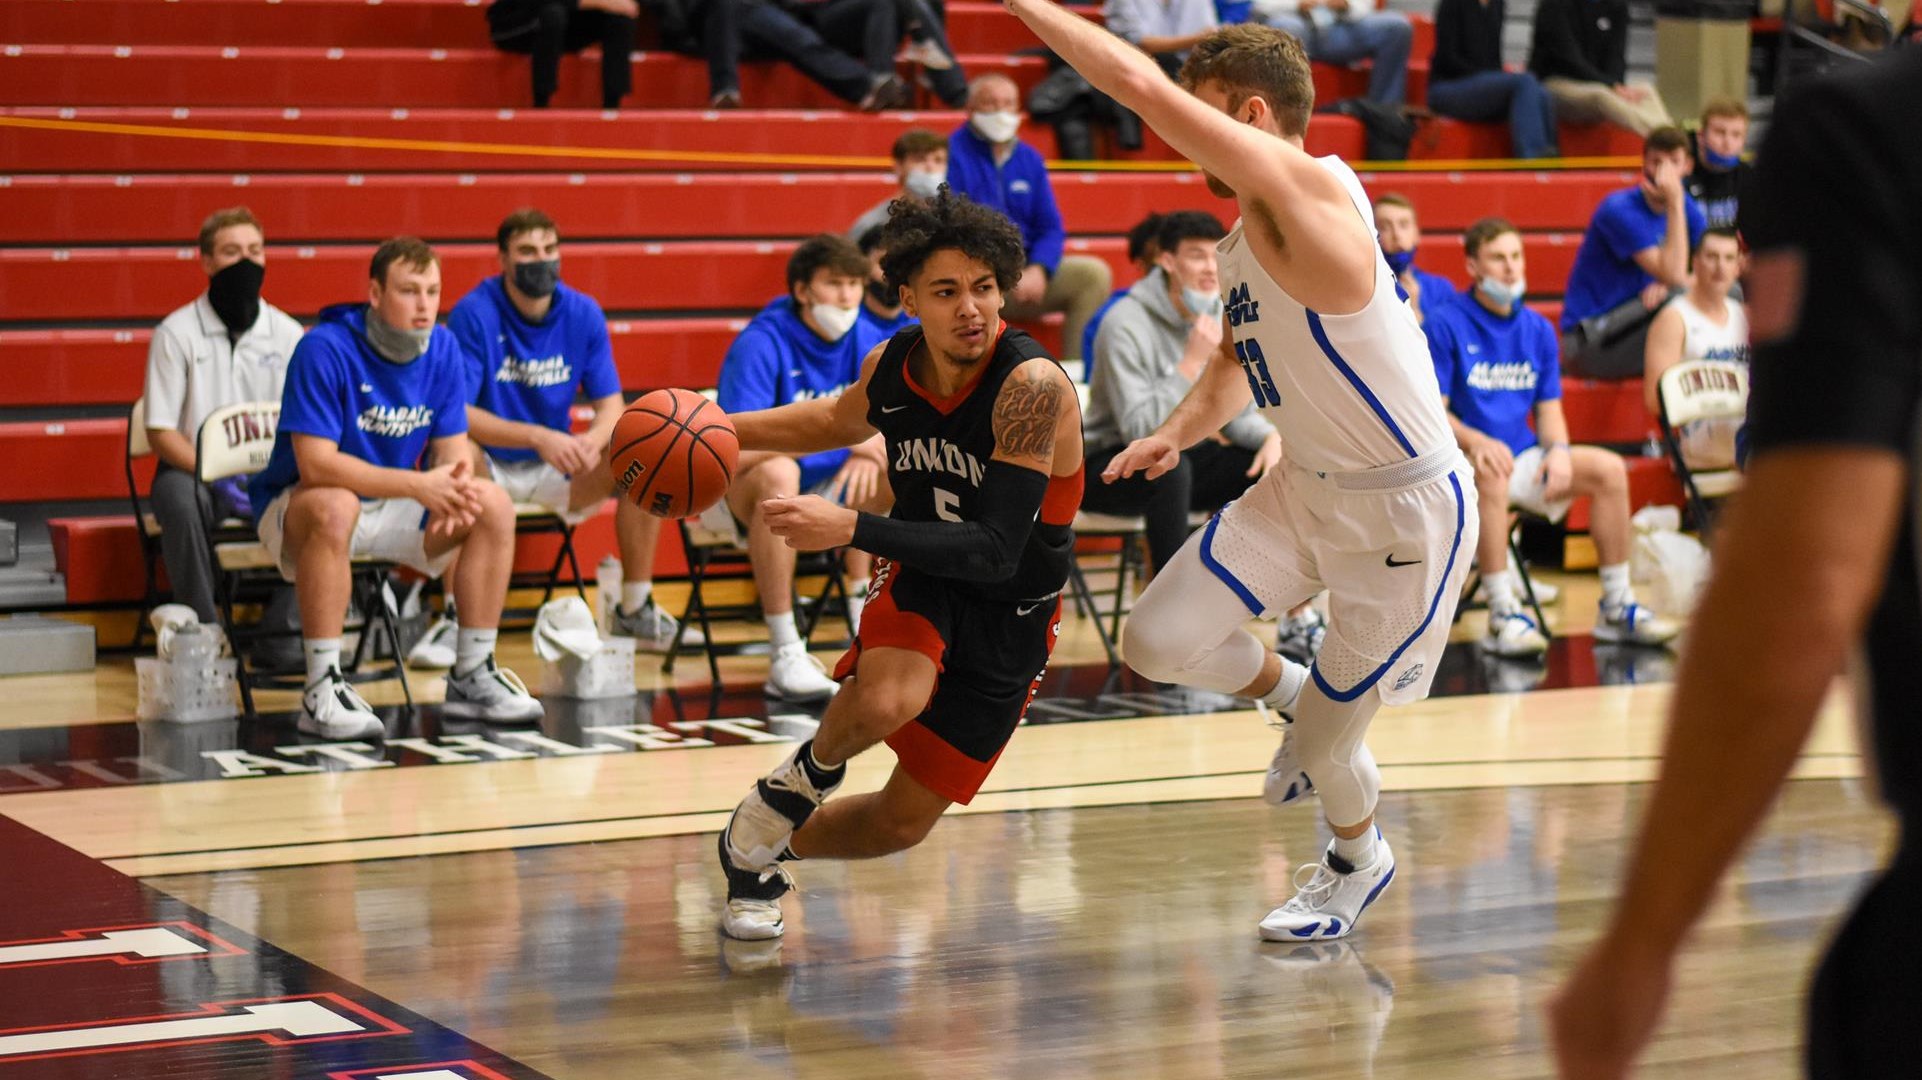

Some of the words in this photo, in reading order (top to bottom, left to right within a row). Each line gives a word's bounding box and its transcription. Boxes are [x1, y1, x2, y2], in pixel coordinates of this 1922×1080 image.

[1679, 367, 1740, 397] UNION
[222, 410, 279, 450] UNI
[895, 437, 986, 488] UNION
